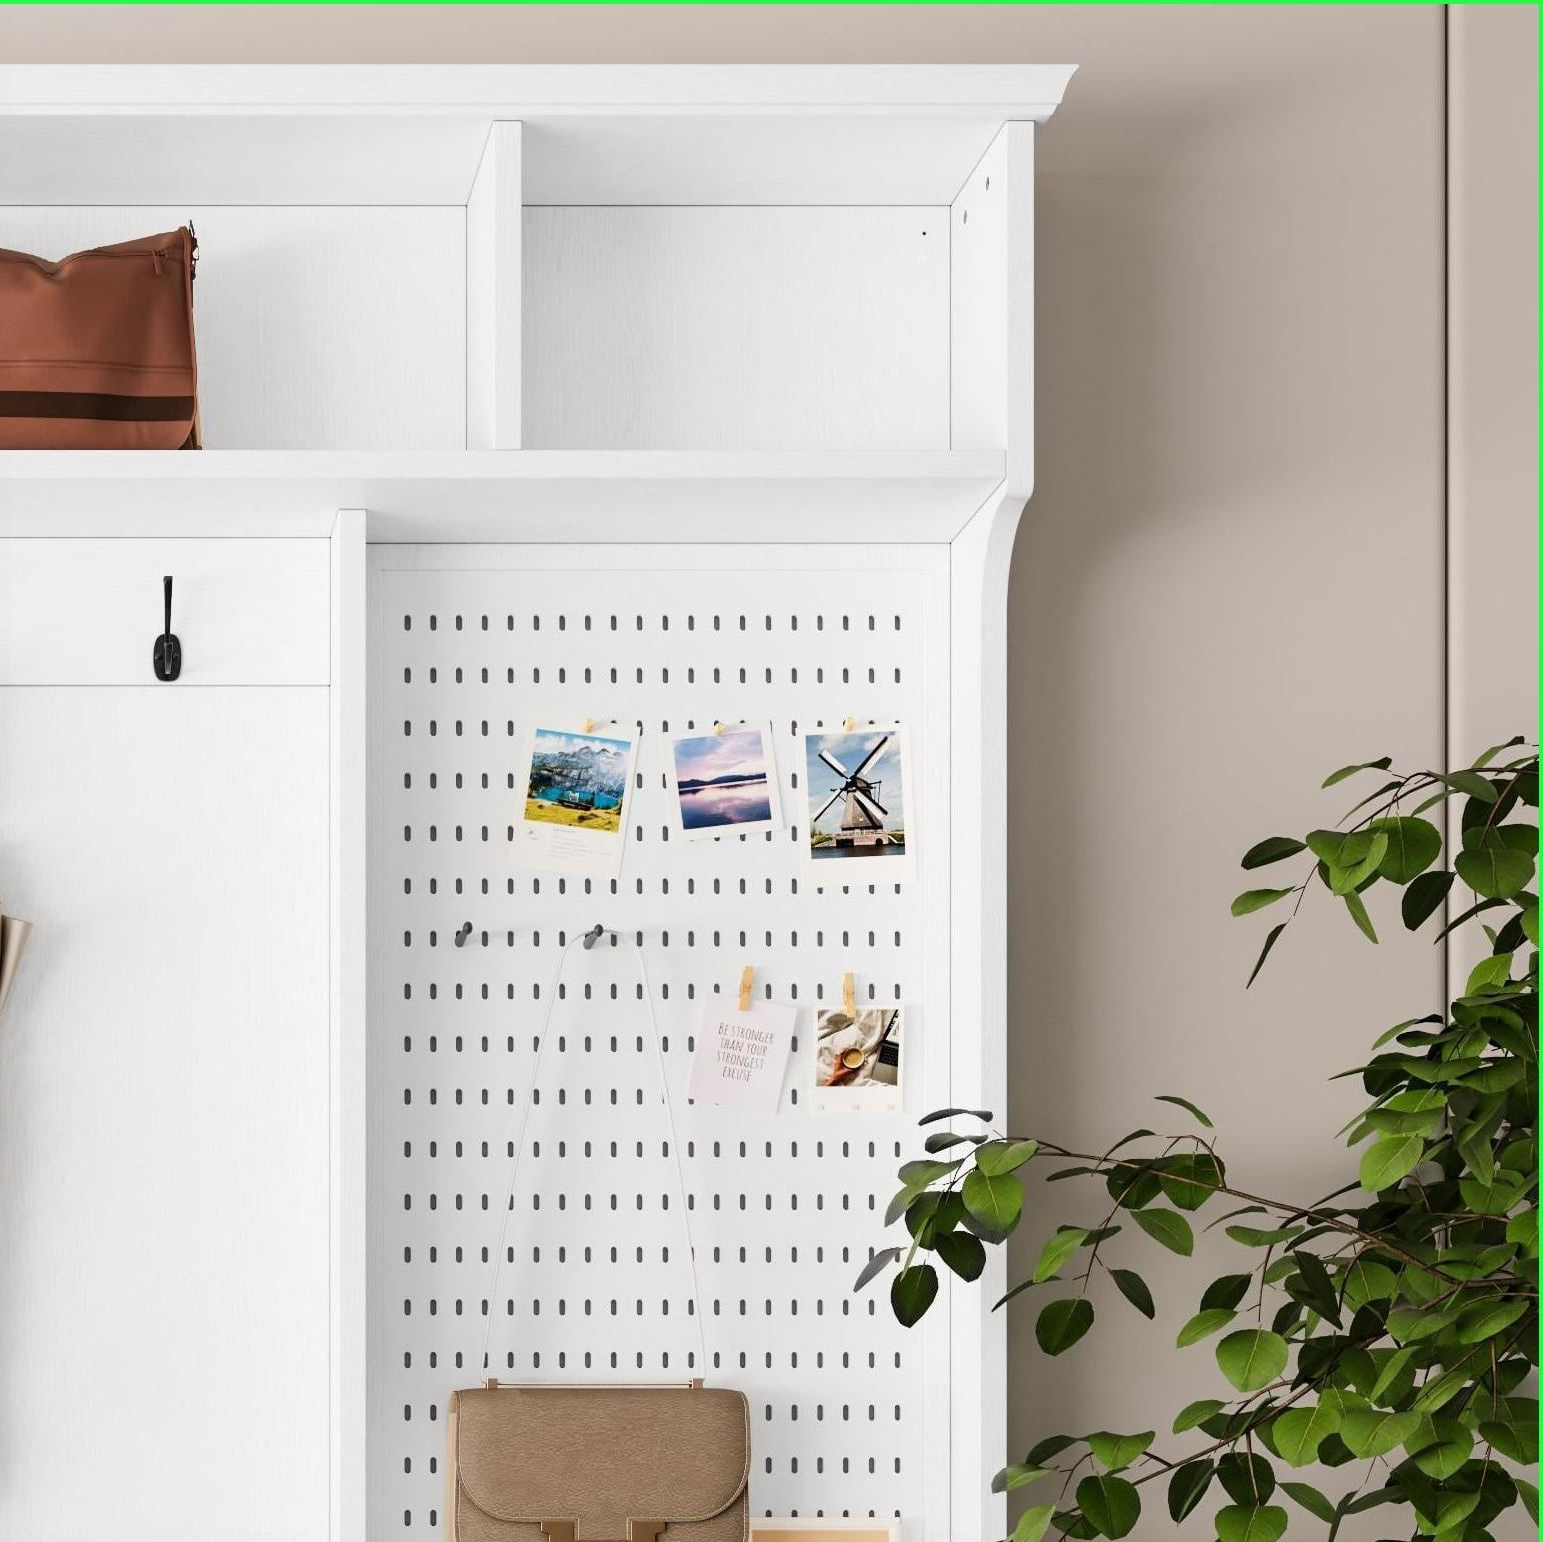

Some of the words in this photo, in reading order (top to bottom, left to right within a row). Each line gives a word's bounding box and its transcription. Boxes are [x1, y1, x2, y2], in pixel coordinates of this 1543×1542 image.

[718, 1022, 728, 1036] BE
[732, 1025, 774, 1044] STRONGER
[720, 1038, 744, 1052] THAN
[747, 1043, 768, 1056] YOUR
[717, 1051, 764, 1069] STRONGEST
[722, 1065, 752, 1082] EXCUSE
